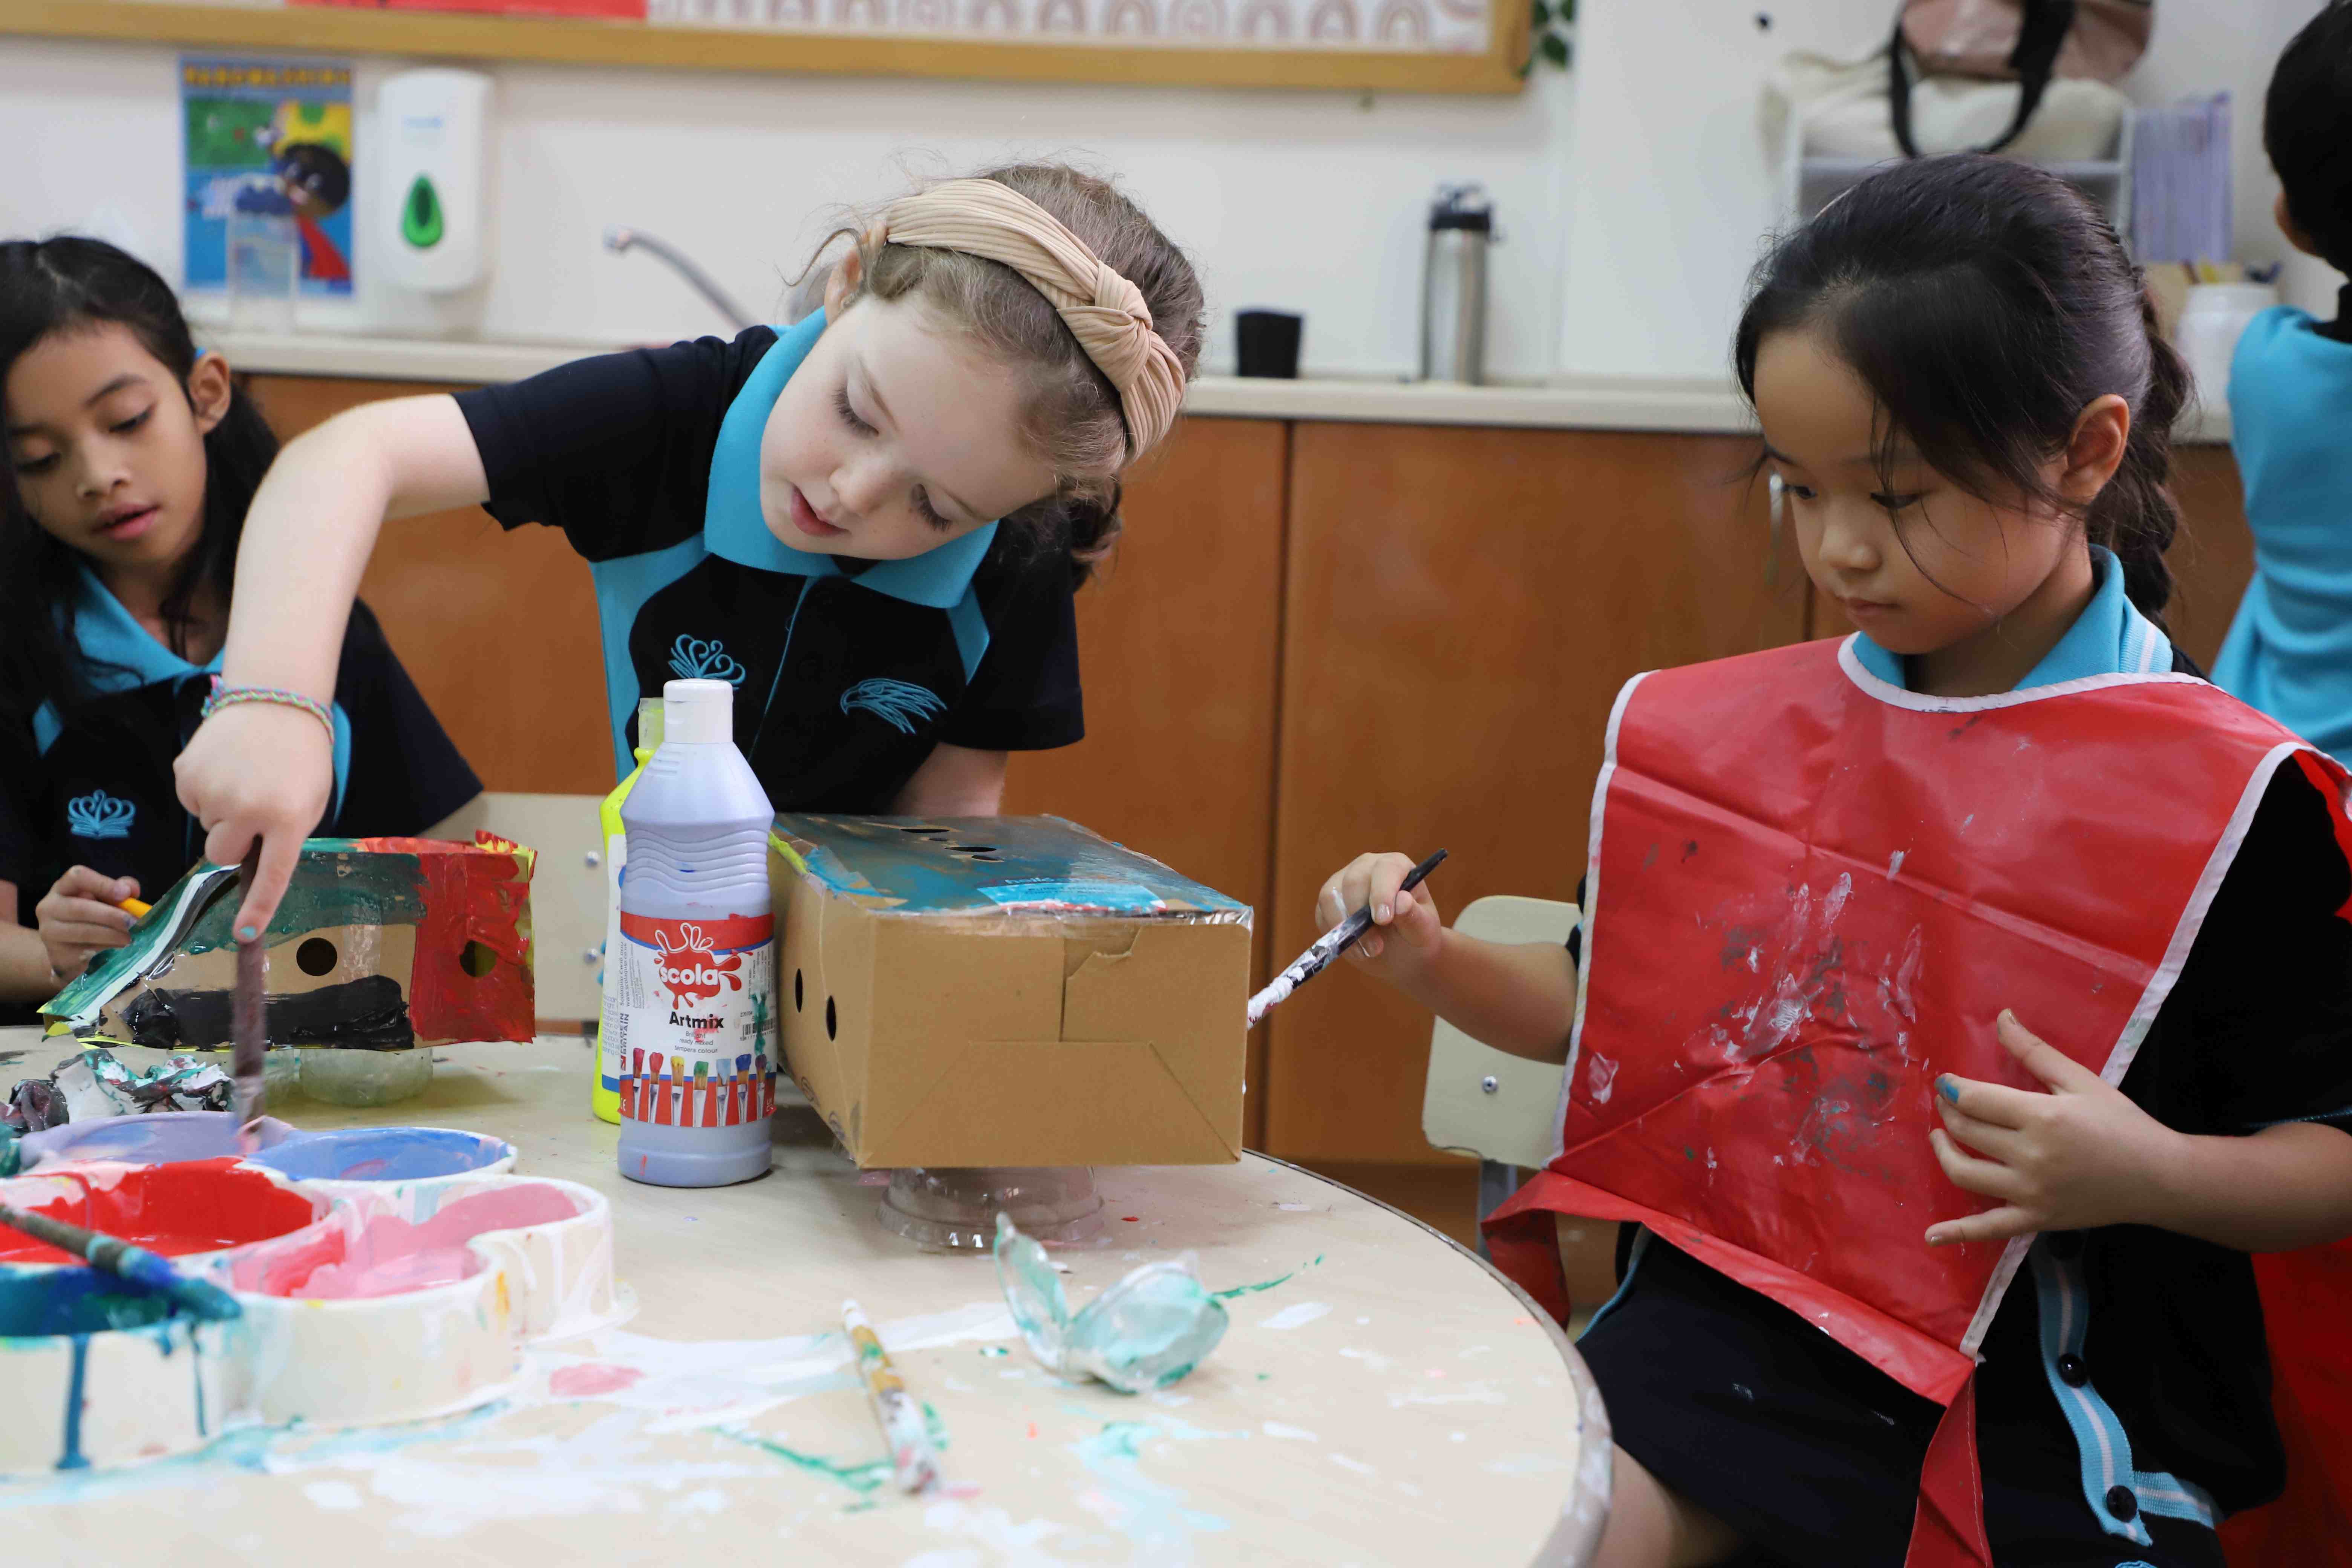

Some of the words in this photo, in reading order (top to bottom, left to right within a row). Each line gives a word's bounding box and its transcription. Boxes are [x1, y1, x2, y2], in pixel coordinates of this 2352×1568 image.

[660, 963, 718, 986] scola
[620, 1013, 624, 1023] IN
[669, 1011, 724, 1029] Artmix
